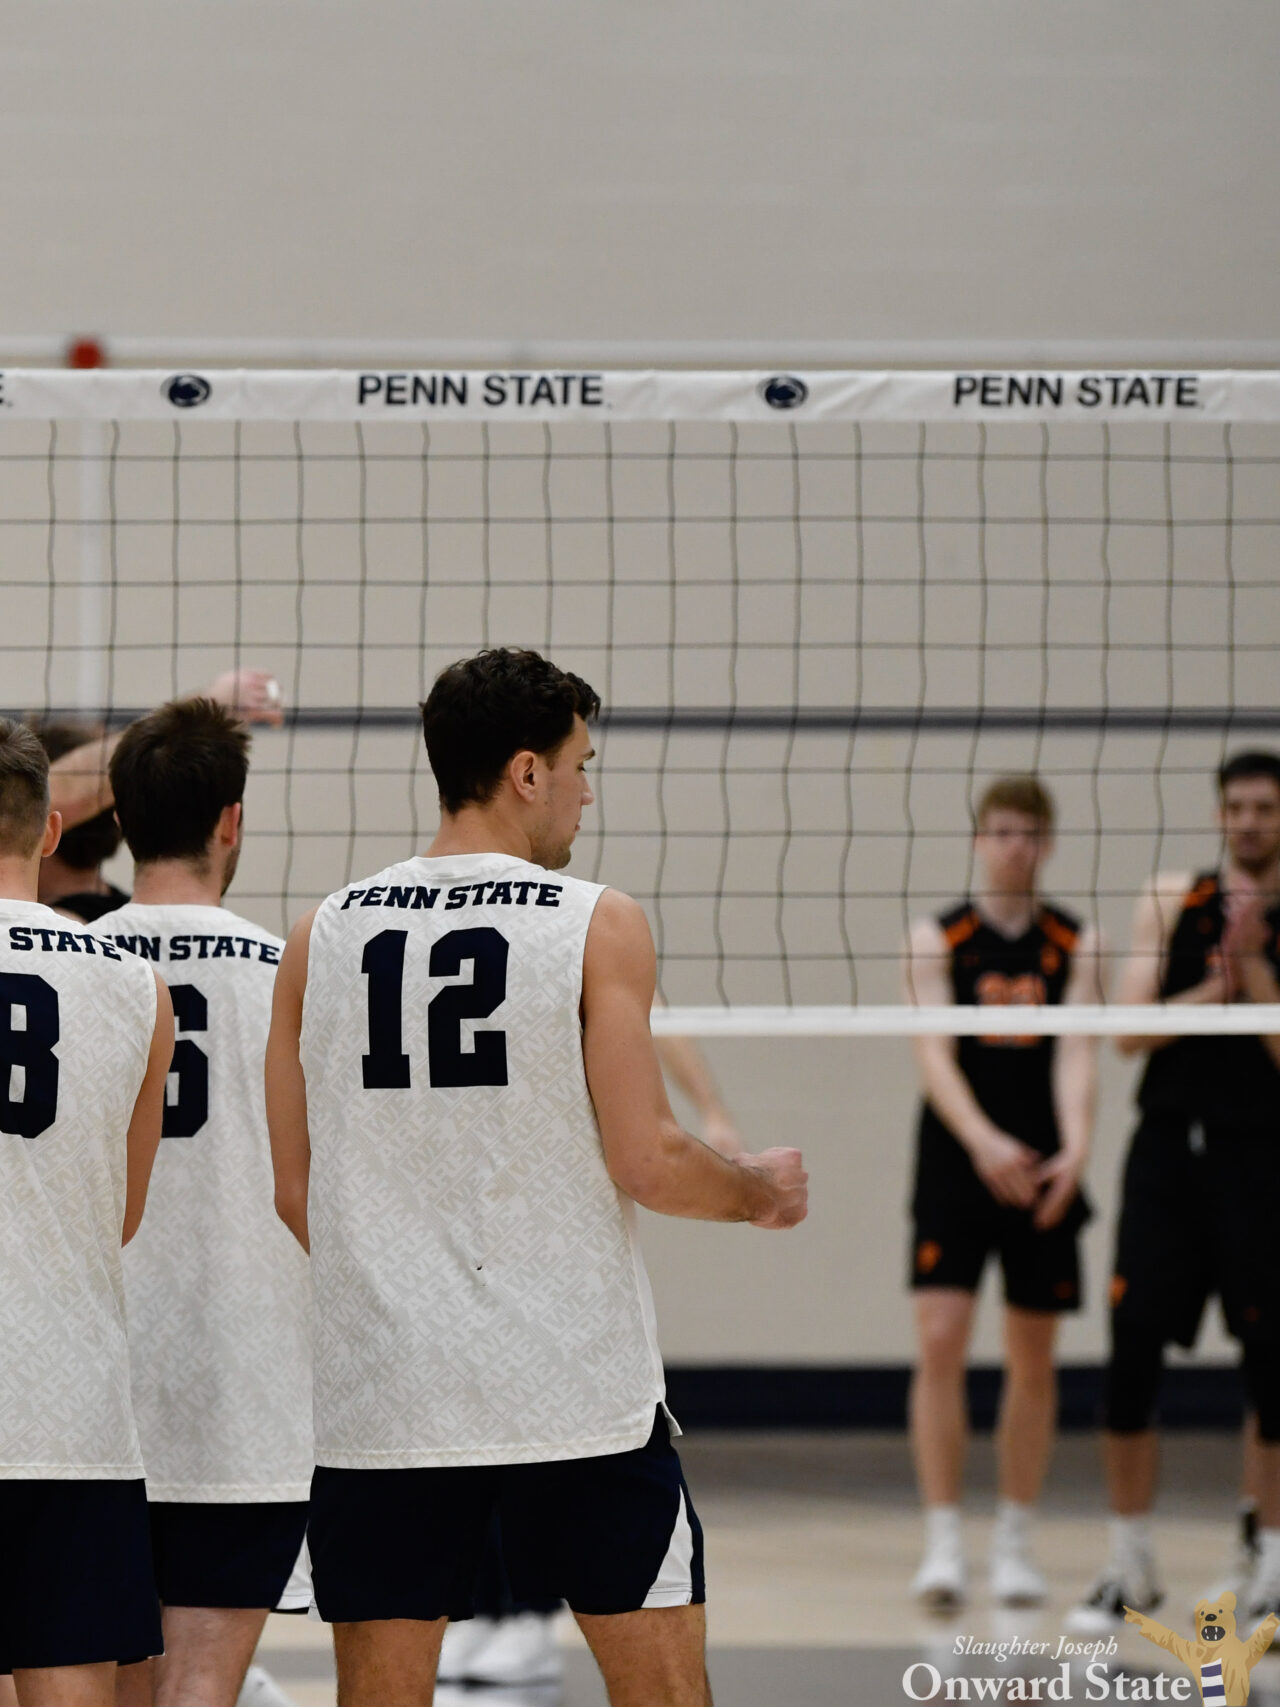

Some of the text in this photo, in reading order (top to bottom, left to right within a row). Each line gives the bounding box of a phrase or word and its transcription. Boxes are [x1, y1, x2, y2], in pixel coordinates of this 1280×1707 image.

[357, 375, 603, 407] PENN STATE
[953, 376, 1198, 408] PENN STATE
[340, 880, 564, 911] PENN STATE
[9, 926, 122, 962] STATE
[169, 935, 280, 966] STATE
[360, 926, 510, 1090] 12
